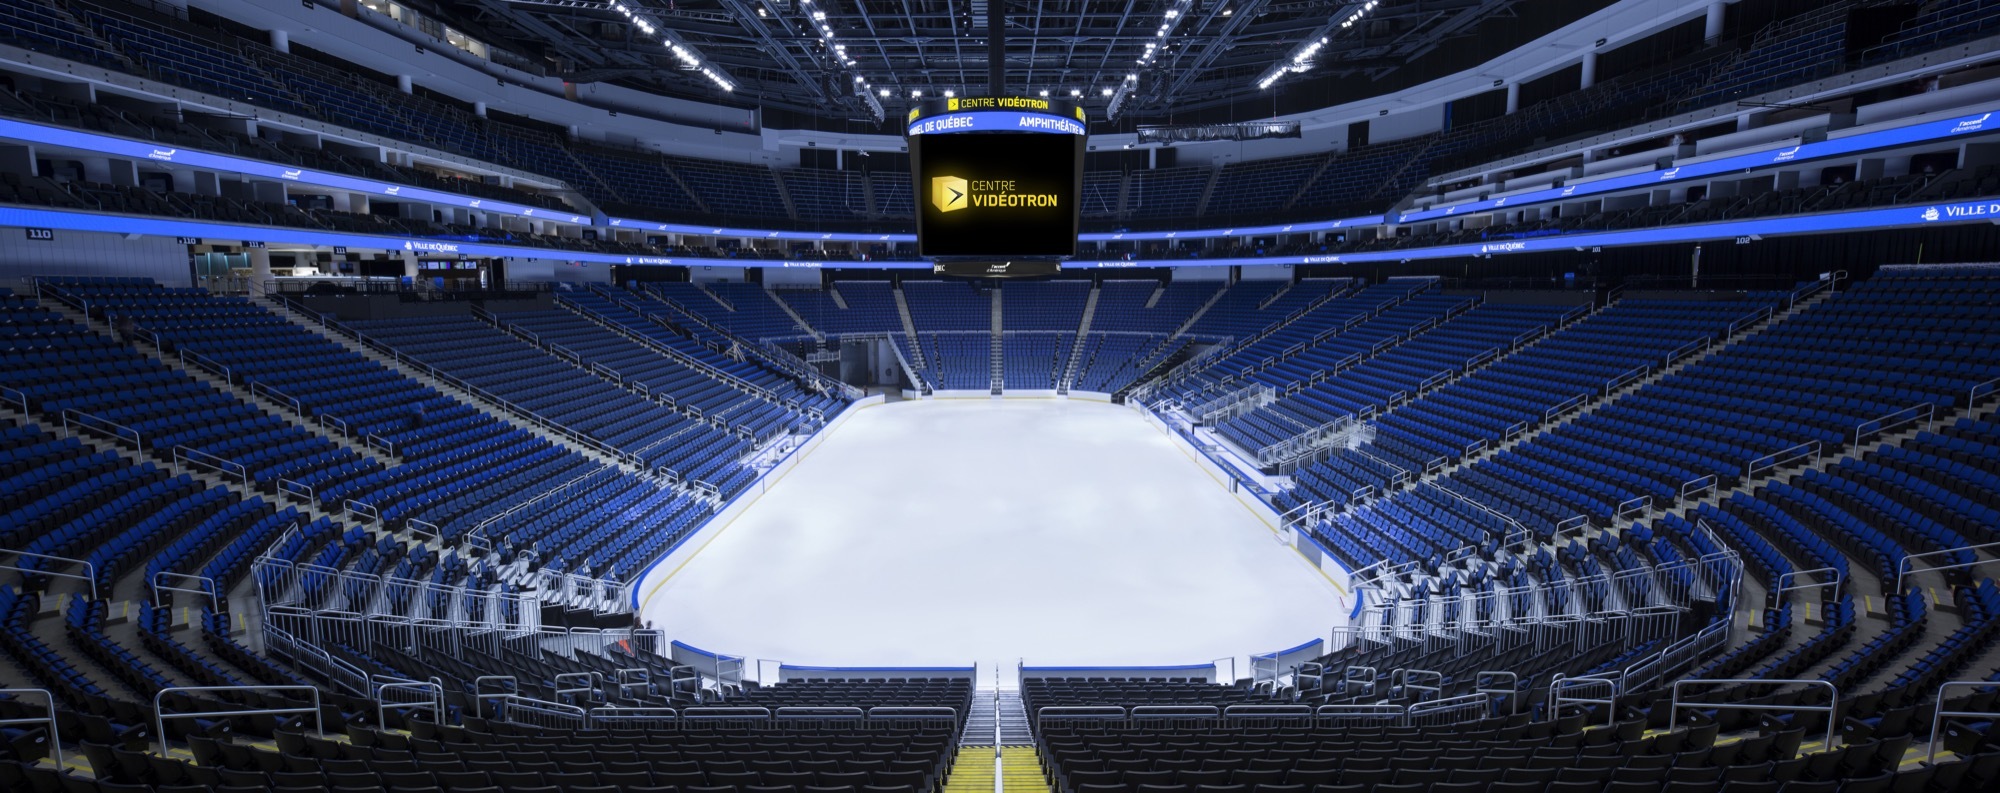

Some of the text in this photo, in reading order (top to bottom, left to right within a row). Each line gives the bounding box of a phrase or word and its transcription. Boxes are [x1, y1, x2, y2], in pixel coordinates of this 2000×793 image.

[961, 96, 1048, 109] CENTRE VIDÉOTRON
[925, 121, 935, 132] DE
[936, 115, 973, 131] QUÉBEC
[1019, 116, 1079, 135] AMPHITHÉÂTRE
[971, 181, 1015, 191] CENTRE
[973, 191, 1058, 207] VIDÉOTRON
[1946, 205, 1985, 217] VILLE
[30, 229, 51, 239] 110
[183, 237, 196, 245] 110
[1736, 236, 1750, 244] 102
[335, 246, 346, 254] 111
[413, 241, 428, 249] VILLE
[436, 242, 458, 252] QUÉBEC
